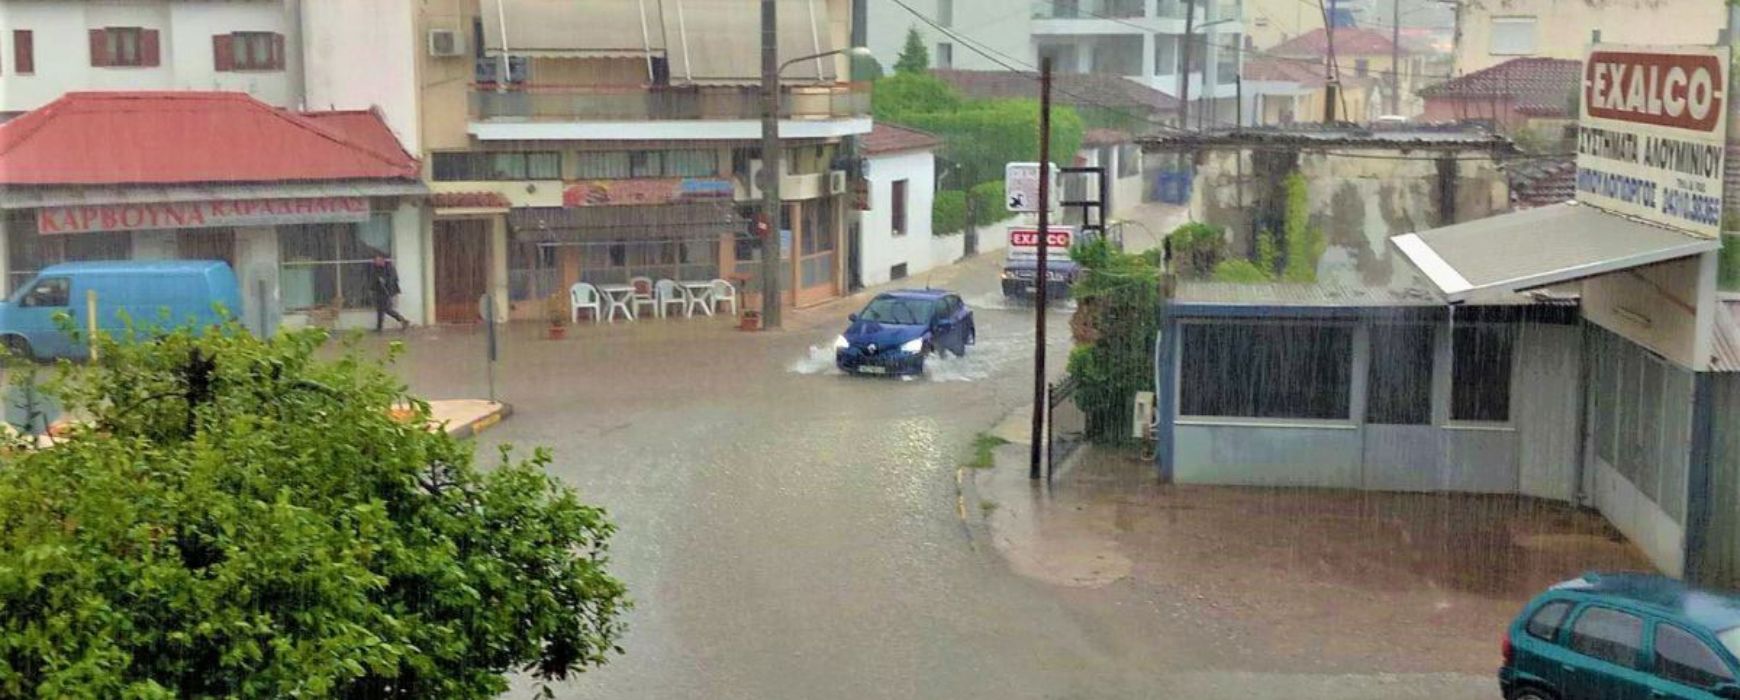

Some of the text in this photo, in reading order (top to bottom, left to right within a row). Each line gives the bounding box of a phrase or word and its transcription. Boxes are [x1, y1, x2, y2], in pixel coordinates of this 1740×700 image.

[1592, 62, 1712, 120] EXALCO
[1579, 126, 1723, 179] ΣΥΣΤΗΜΑΤΑ ΑΛΟΥΜΙΝΙΟΥ
[40, 205, 205, 232] ΚΑΡΒΟΥΝΑ
[1013, 233, 1066, 245] EXACO
